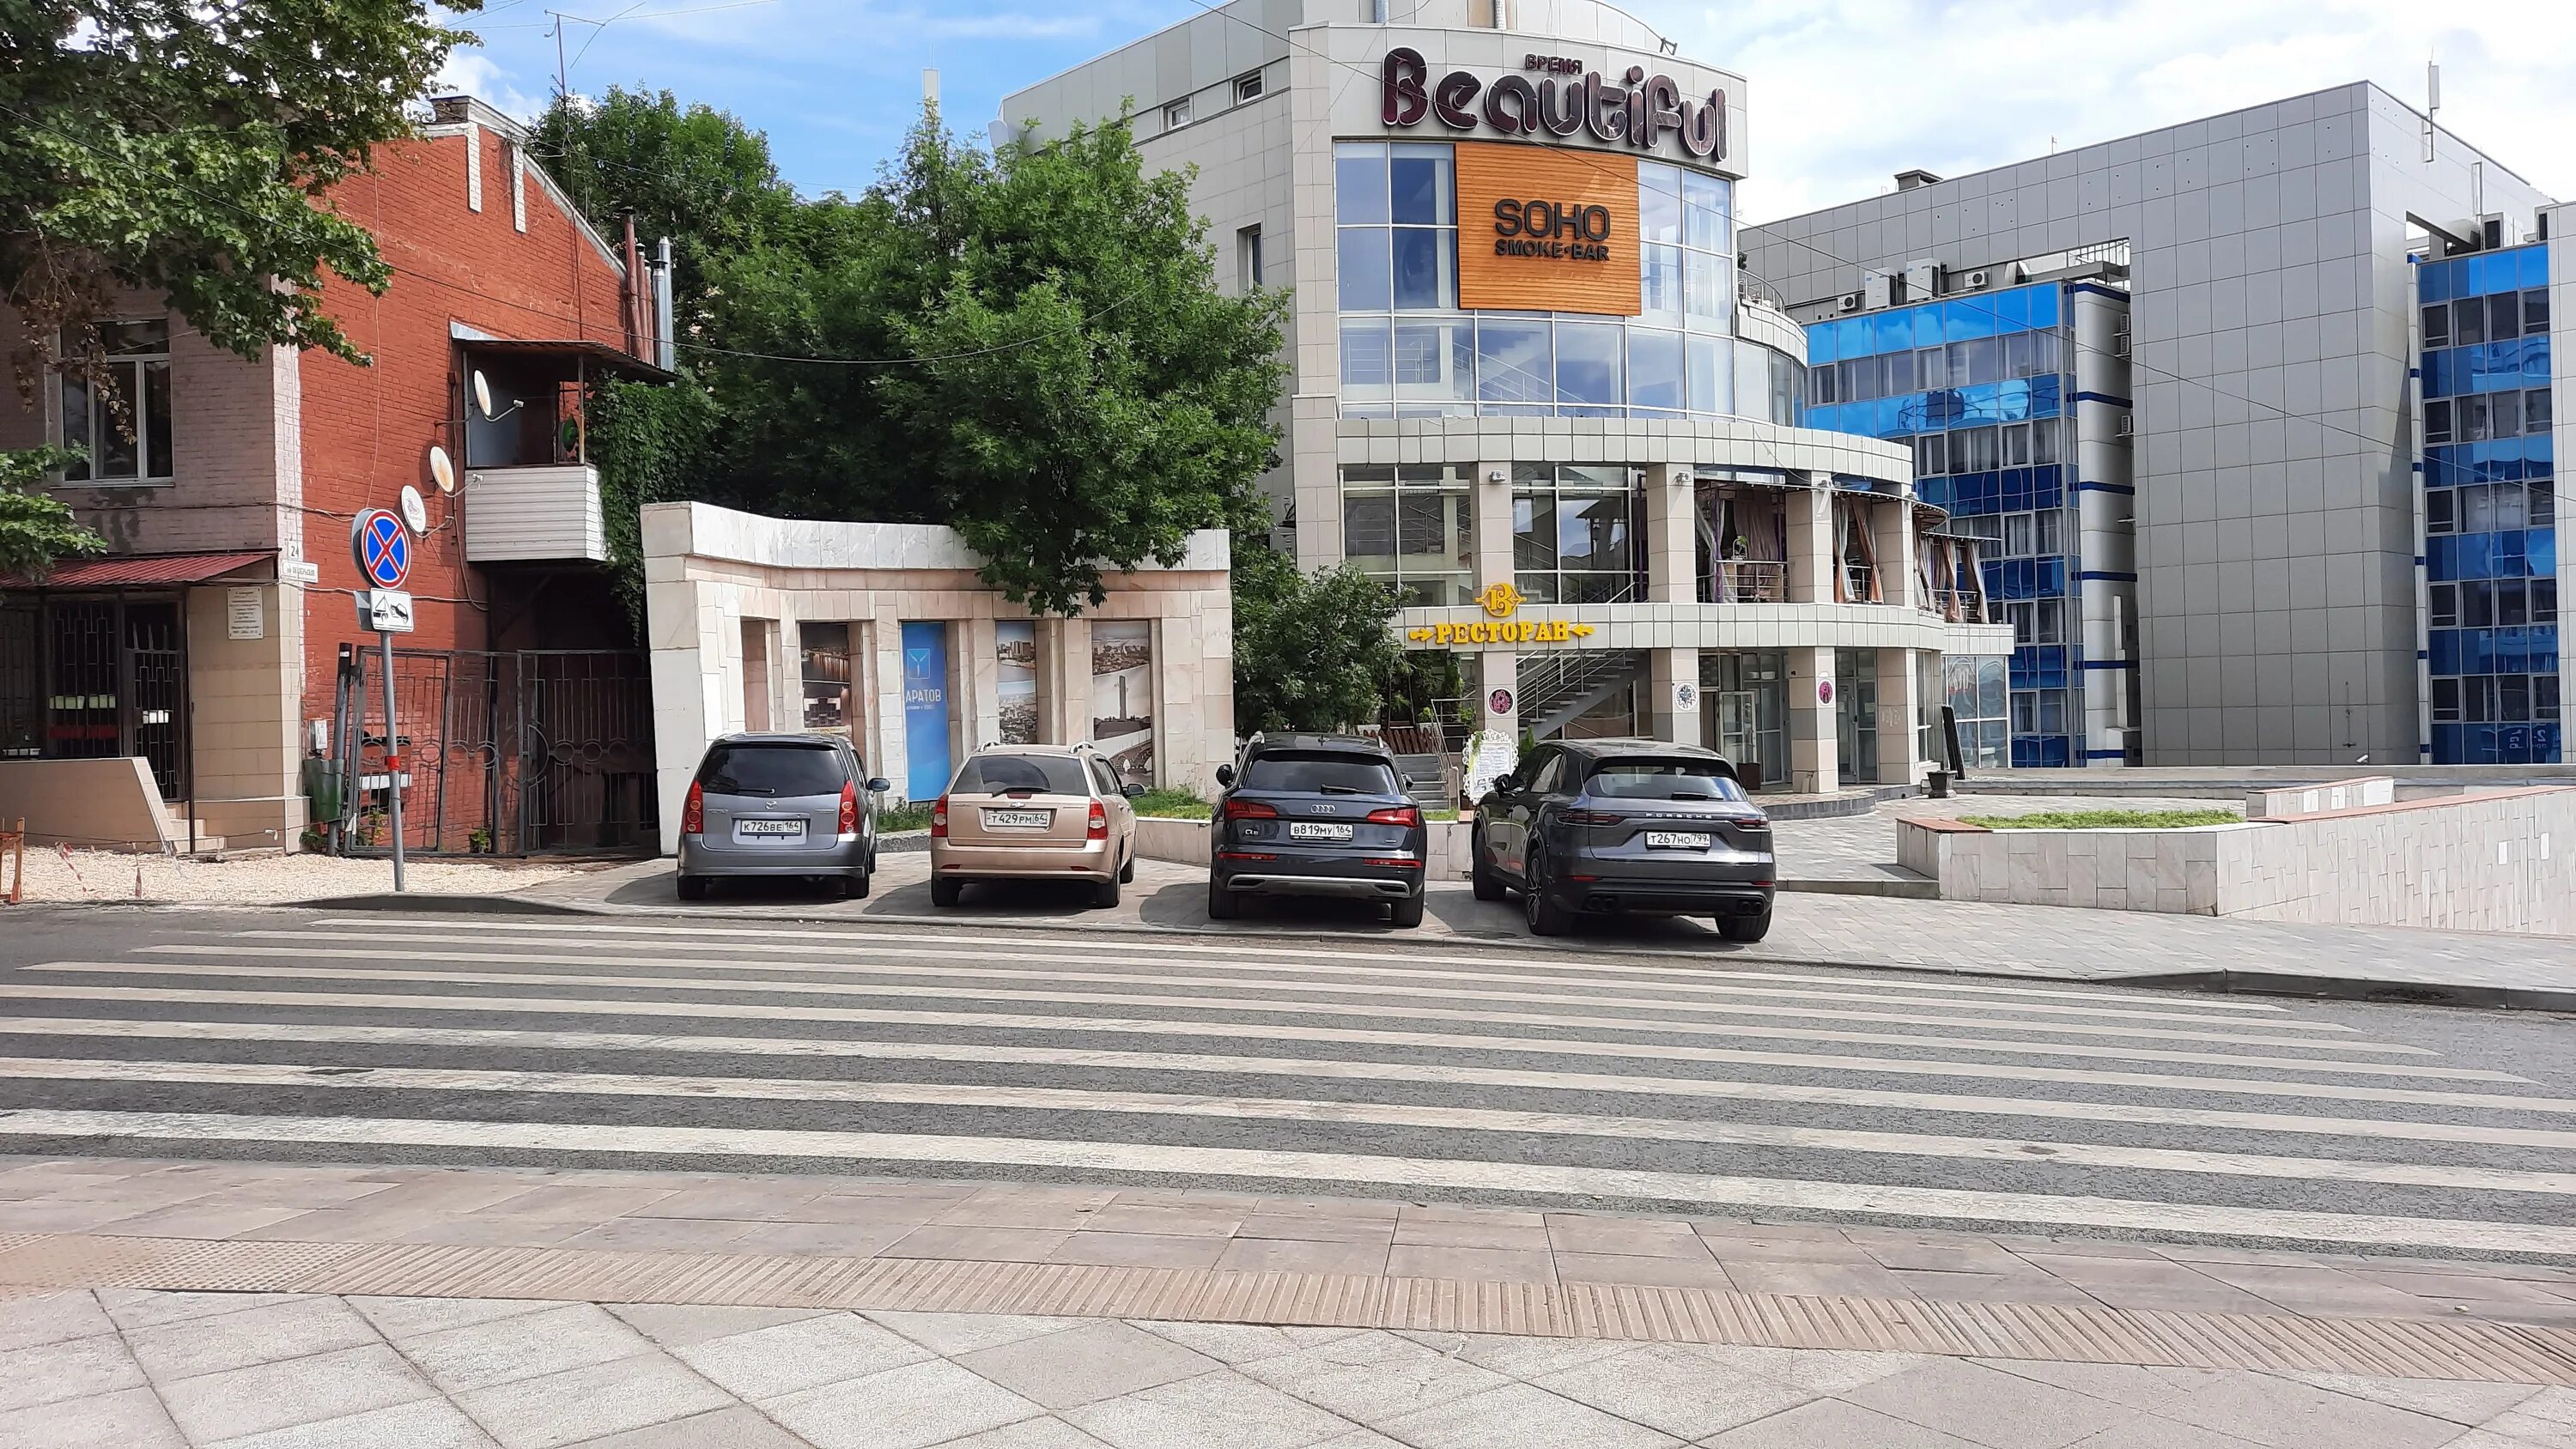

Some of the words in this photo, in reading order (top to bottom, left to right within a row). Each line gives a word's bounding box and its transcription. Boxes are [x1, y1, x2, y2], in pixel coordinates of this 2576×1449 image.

[1525, 53, 1583, 75] ВРЕМЯ
[1381, 45, 1728, 162] Beautiful
[1495, 198, 1611, 242] SOHO
[1436, 621, 1571, 644] РЕСТОРАН
[905, 688, 942, 703] АРАТОВ
